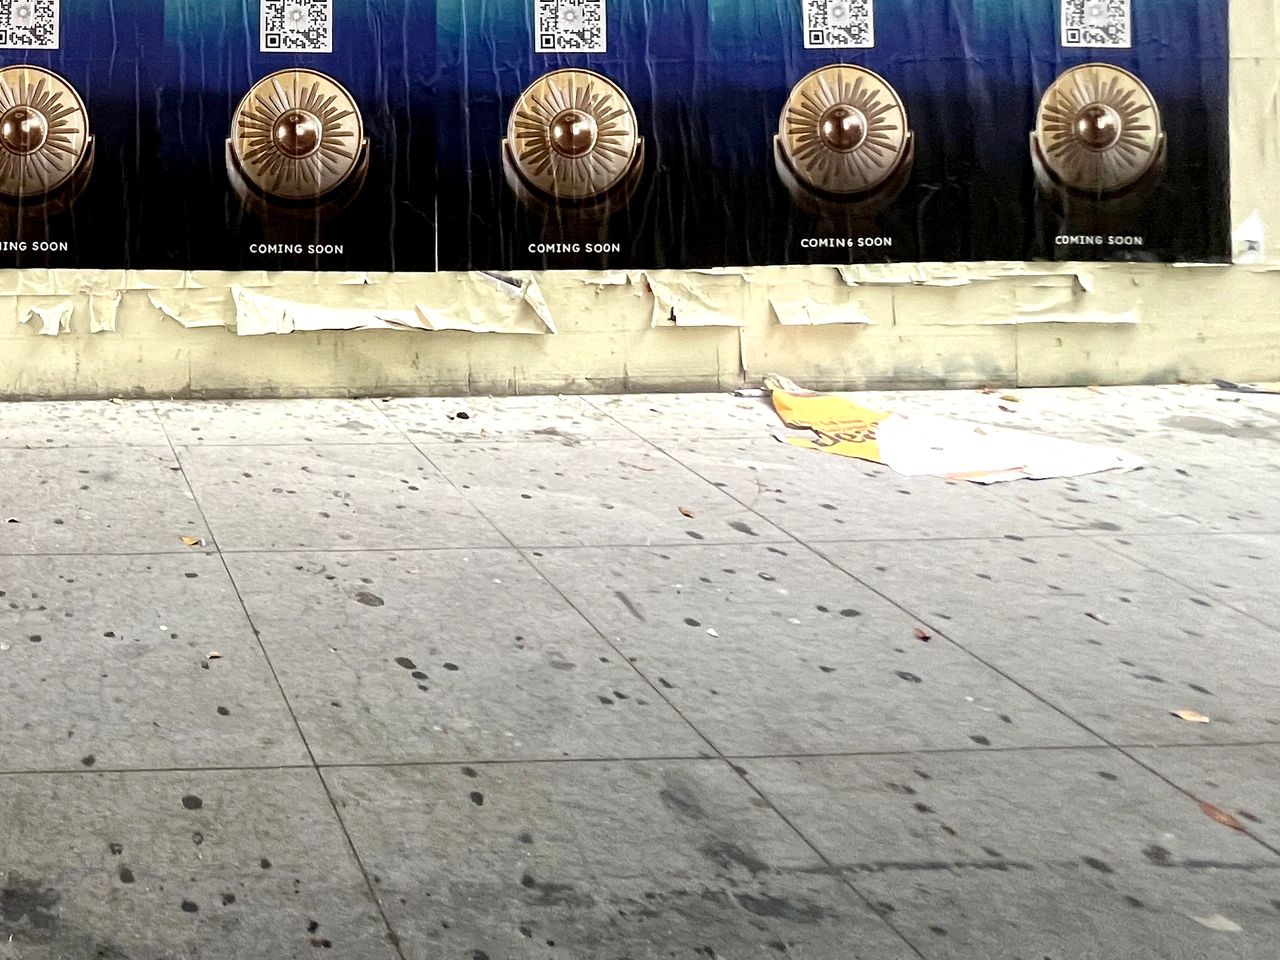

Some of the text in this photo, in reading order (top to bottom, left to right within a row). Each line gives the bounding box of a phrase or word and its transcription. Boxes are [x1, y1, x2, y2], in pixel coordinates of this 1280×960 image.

[801, 237, 892, 247] COMING SOON
[1055, 236, 1142, 245] COMING SOON
[32, 241, 68, 251] SOON
[249, 244, 343, 254] COMING SOON
[528, 243, 620, 253] COMING SOON
